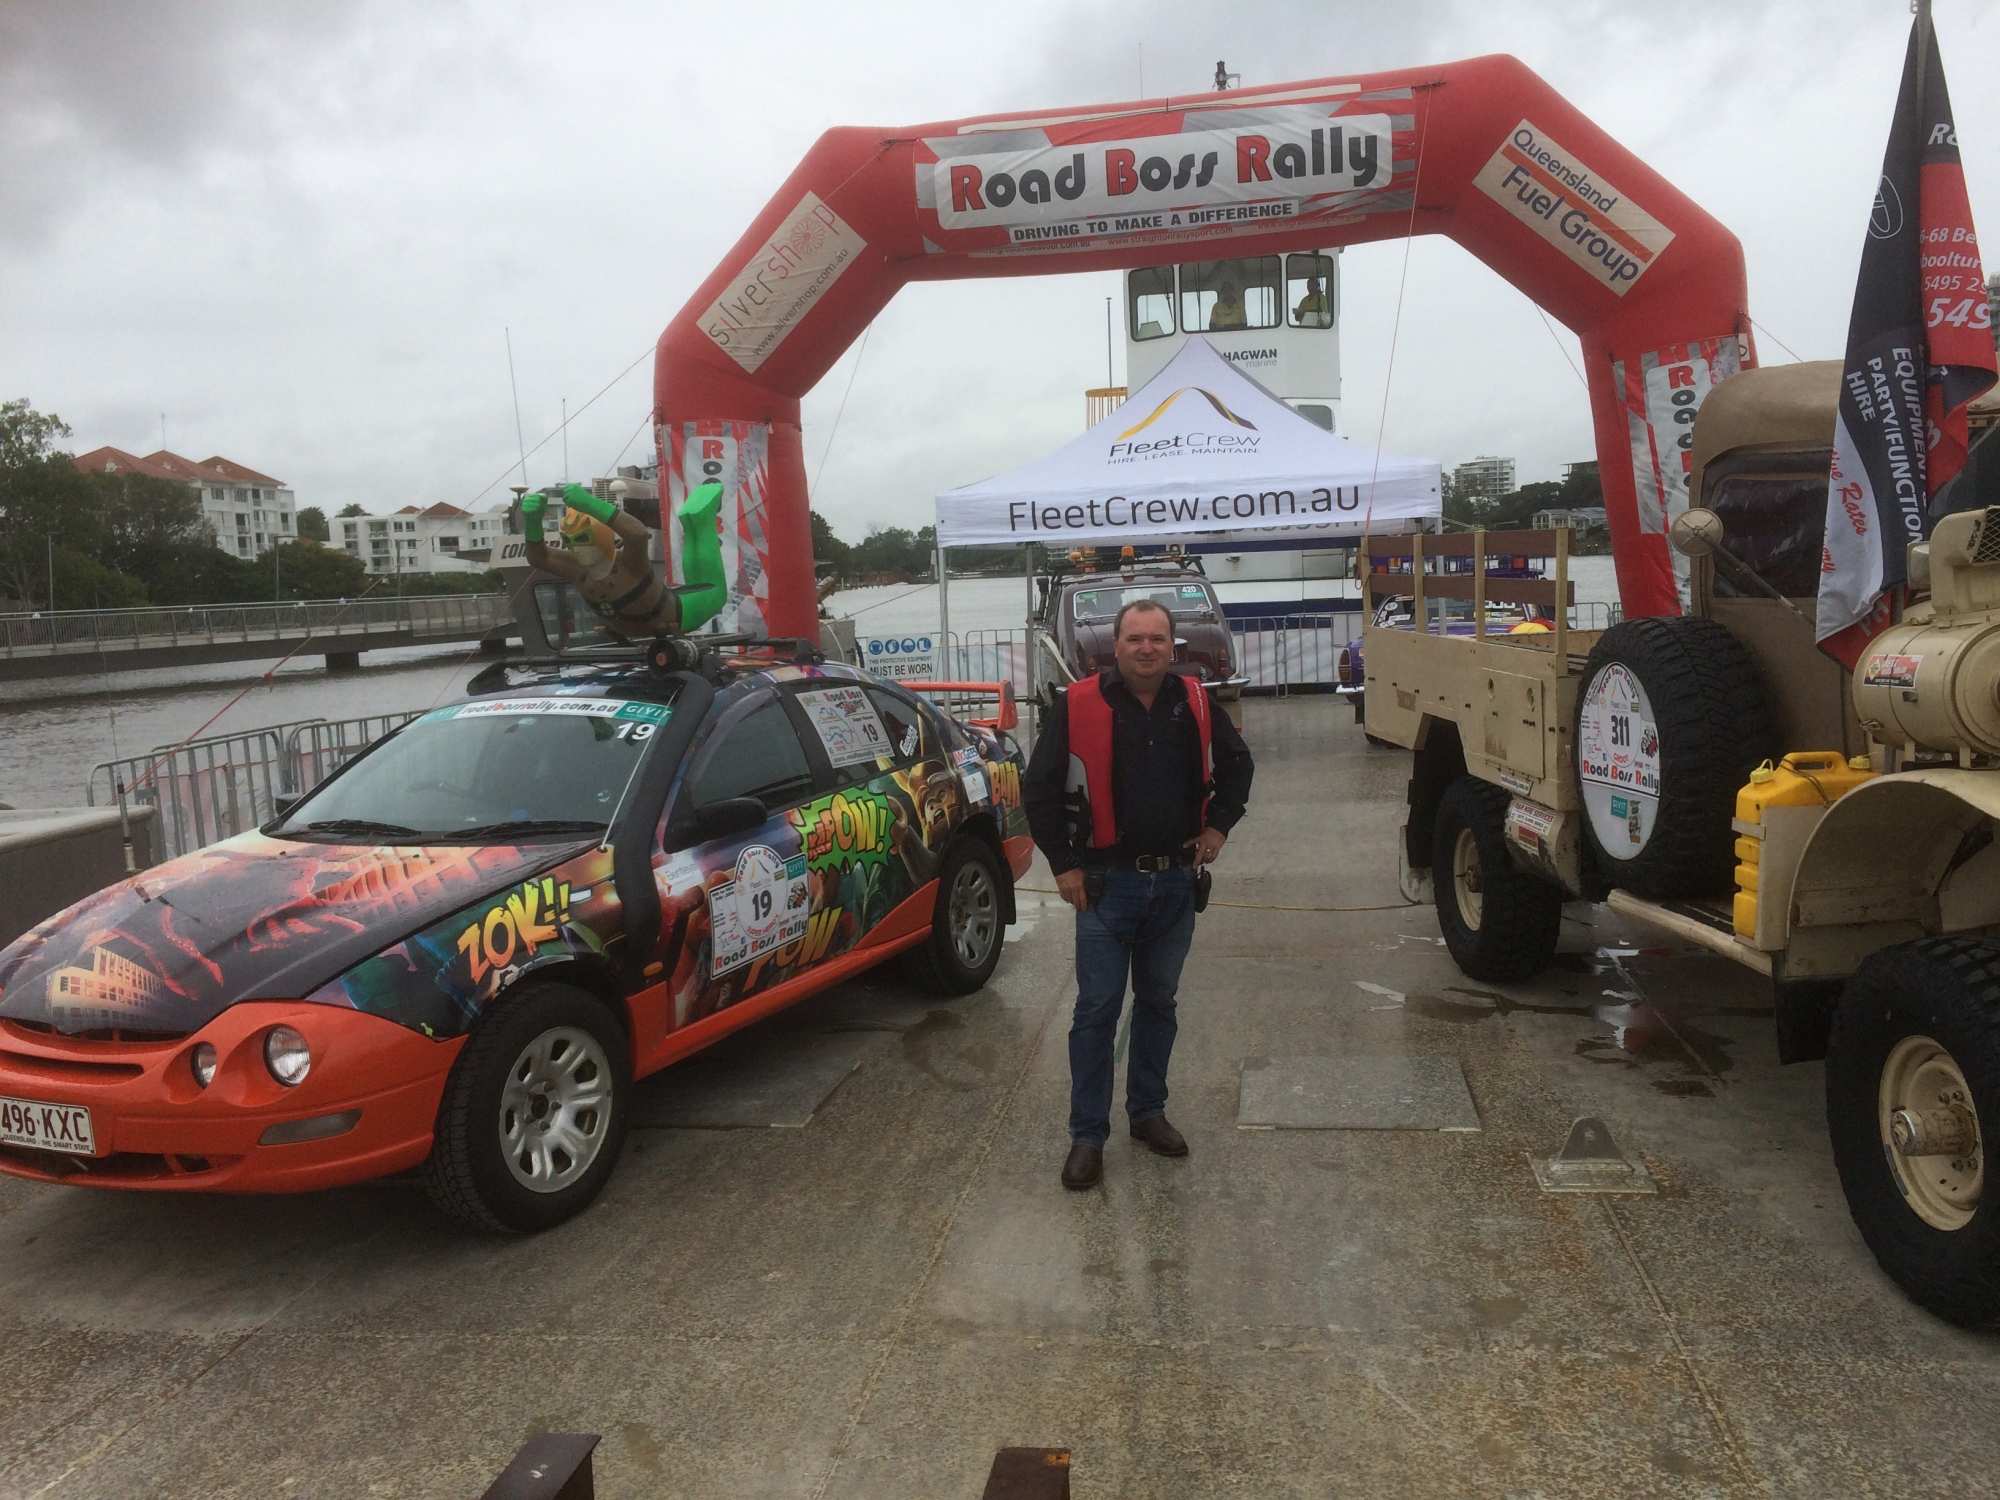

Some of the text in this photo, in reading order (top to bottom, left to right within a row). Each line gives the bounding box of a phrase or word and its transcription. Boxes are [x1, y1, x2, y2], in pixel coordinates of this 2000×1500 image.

[950, 127, 1378, 212] Road Boss Rally
[1514, 129, 1617, 213] Queensland
[1013, 222, 1080, 241] DRIVING
[1087, 220, 1109, 234] TO
[1115, 215, 1162, 232] MAKE
[1171, 214, 1182, 226] A
[1189, 203, 1293, 225] DIFFERENCE
[1502, 164, 1638, 281] Fuel Group
[1246, 359, 1277, 367] marine
[1846, 371, 1876, 422] HIRE
[1109, 432, 1261, 457] FleetCrew
[1009, 485, 1359, 532] FleetCrew.com.au
[1836, 480, 1867, 536] Rates
[869, 664, 933, 677] MUST BE WORN
[617, 722, 657, 740] 19
[863, 723, 879, 742] 19
[1611, 715, 1630, 746] 311
[1583, 760, 1660, 796] Road Boss Rally
[752, 890, 772, 921] 19
[715, 945, 748, 970] Road
[751, 935, 776, 953] Boss
[779, 919, 808, 940] Rally
